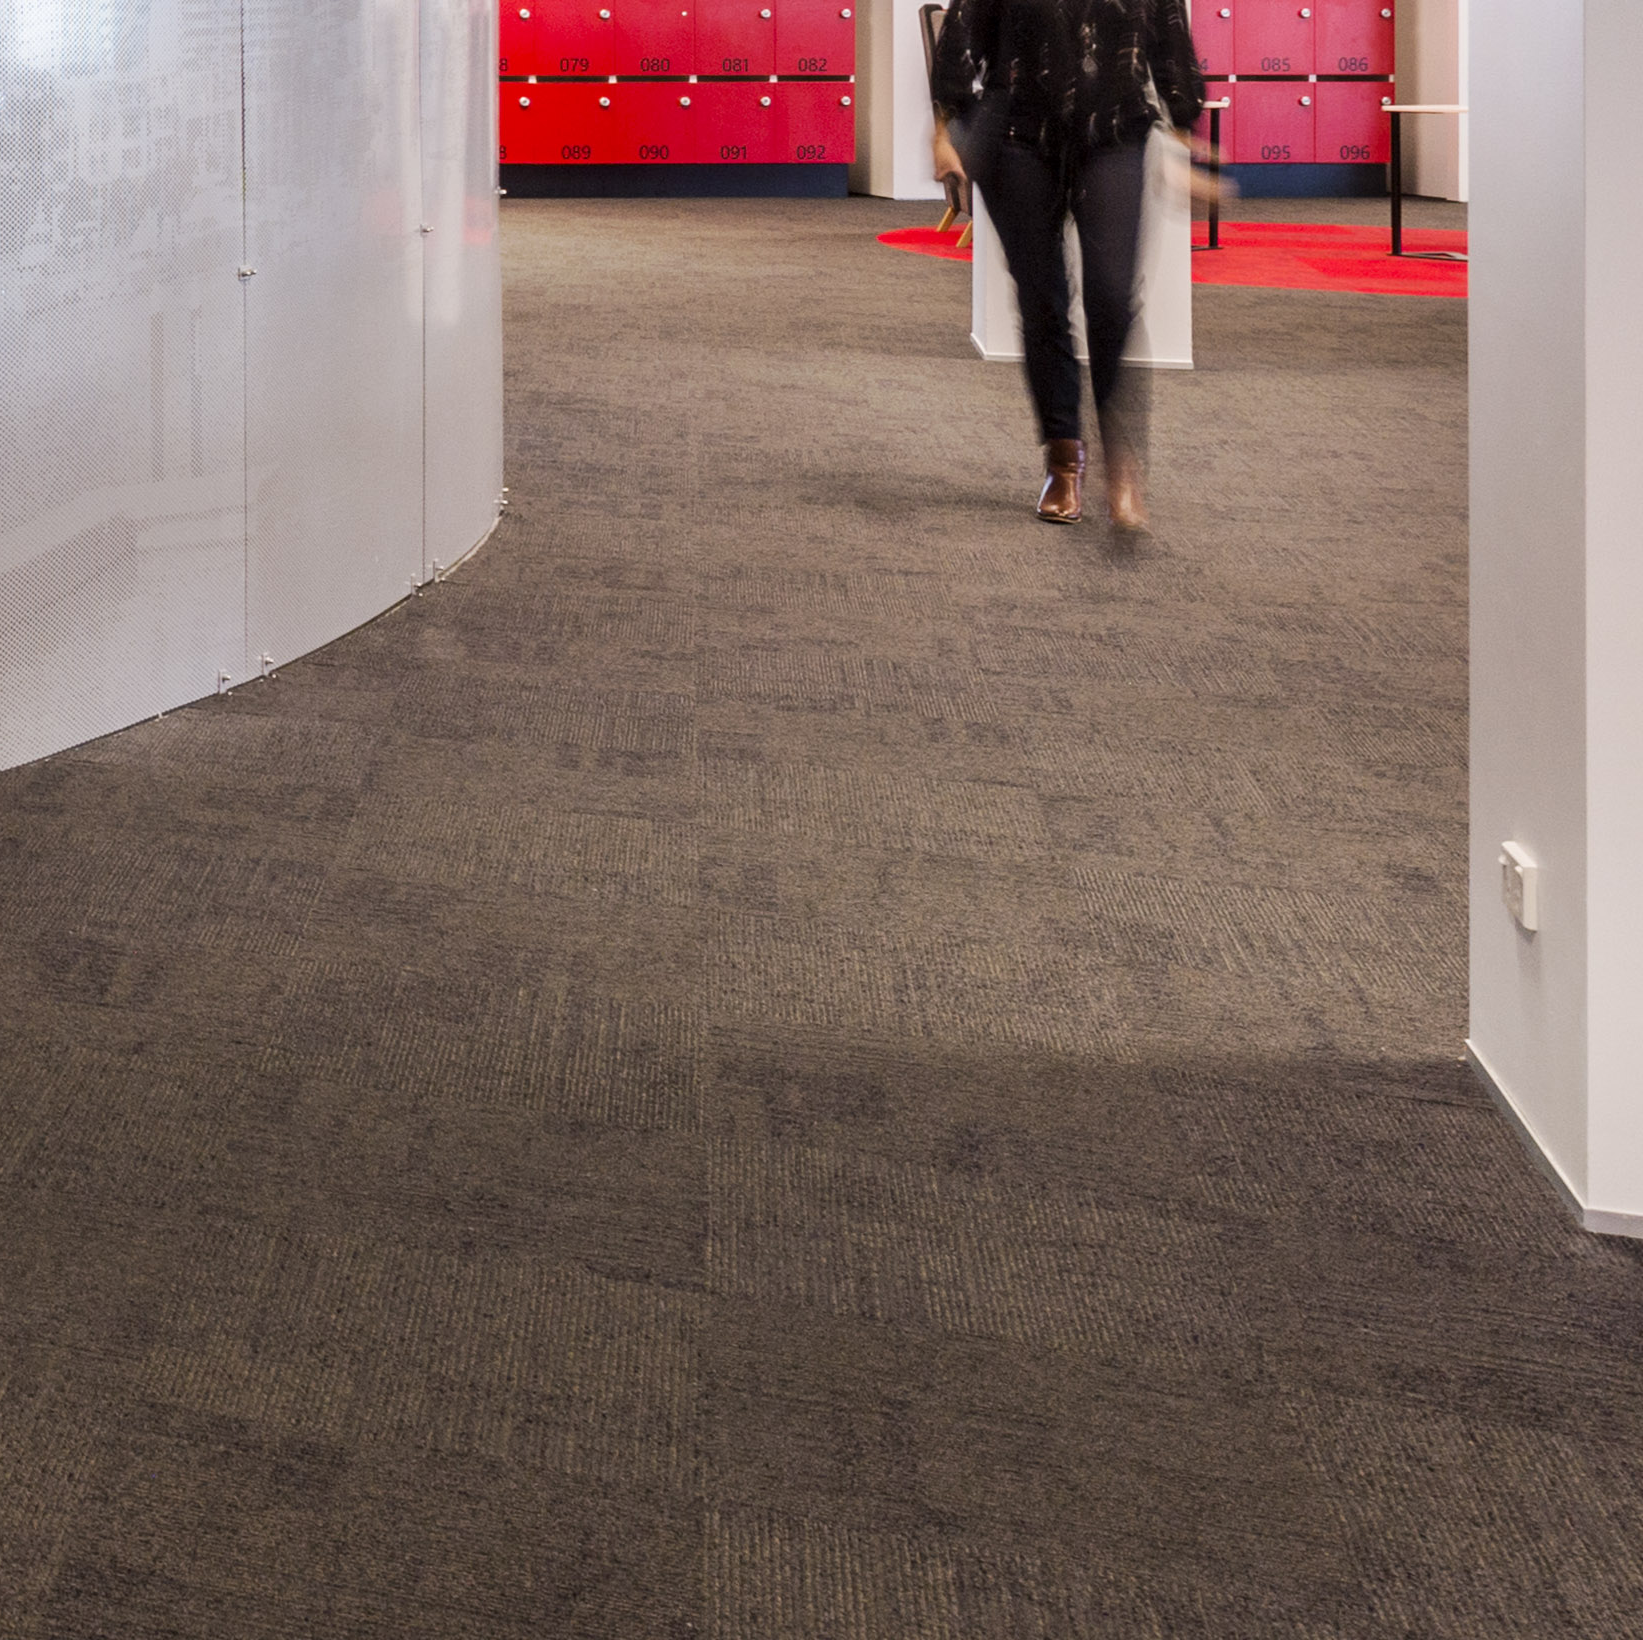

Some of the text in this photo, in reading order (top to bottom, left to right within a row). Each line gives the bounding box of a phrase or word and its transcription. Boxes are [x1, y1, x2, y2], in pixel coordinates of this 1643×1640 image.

[560, 58, 589, 72] 079
[640, 58, 670, 72] 080
[722, 58, 748, 72] 081
[798, 58, 827, 72] 082
[1261, 58, 1290, 72] 085
[1339, 57, 1368, 72] 086
[561, 145, 591, 159] 089
[639, 145, 669, 160] 090
[720, 146, 746, 160] 091
[796, 145, 825, 159] 092
[1261, 145, 1290, 160] 095
[1340, 145, 1370, 160] 096
